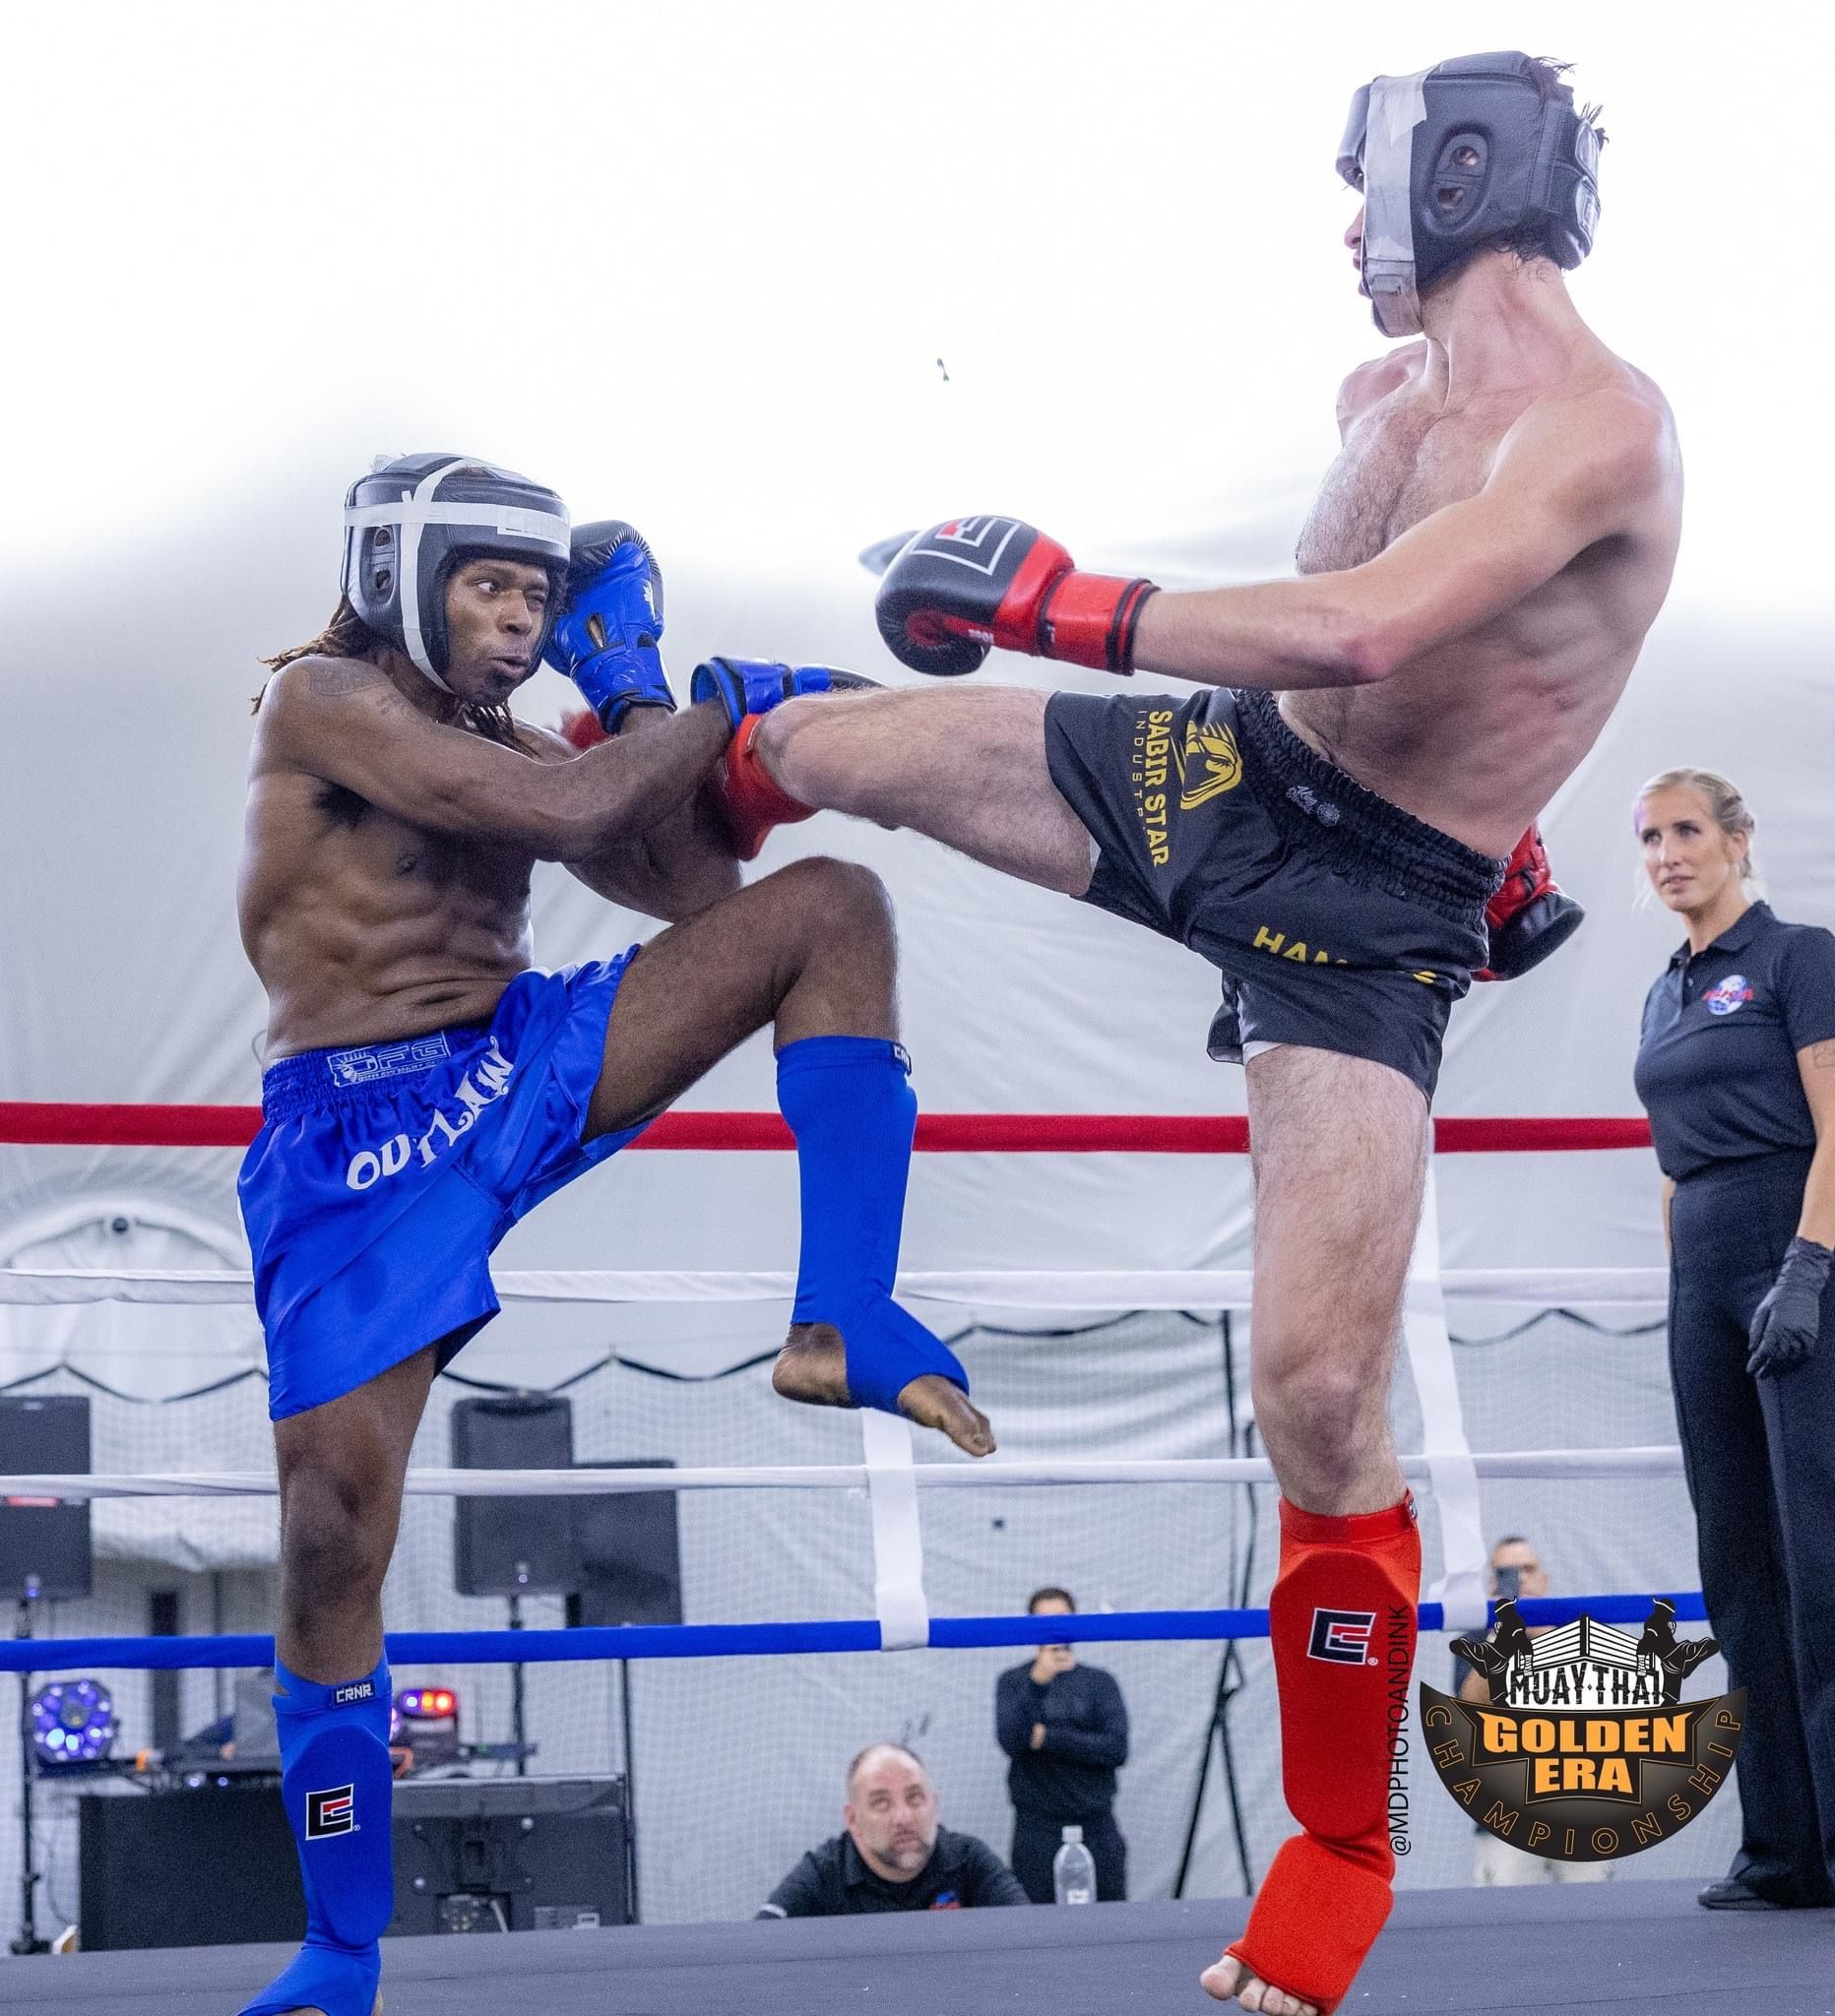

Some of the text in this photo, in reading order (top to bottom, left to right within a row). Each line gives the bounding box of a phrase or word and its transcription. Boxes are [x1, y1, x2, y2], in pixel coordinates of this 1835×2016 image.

[1144, 710, 1173, 867] SABIR STAR
[346, 1036, 514, 1190] OUTLAW
